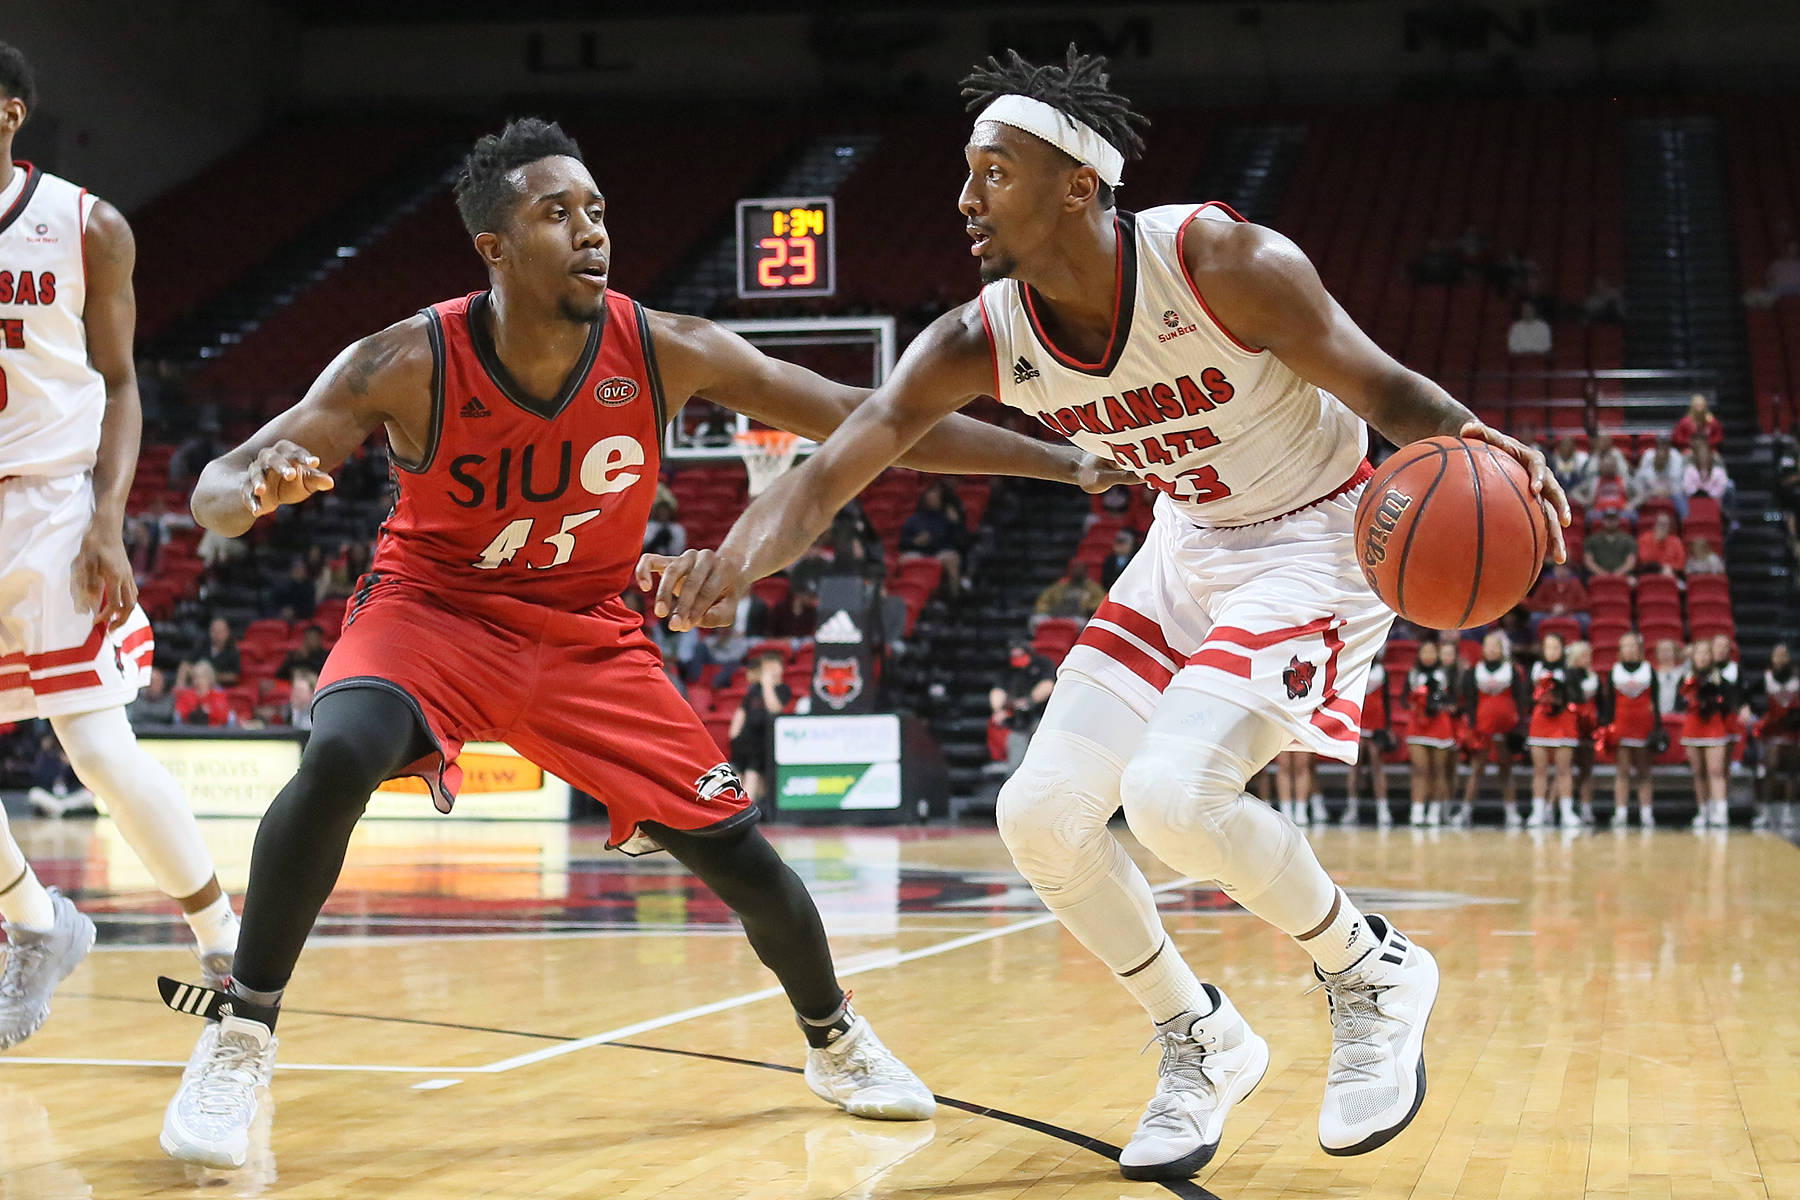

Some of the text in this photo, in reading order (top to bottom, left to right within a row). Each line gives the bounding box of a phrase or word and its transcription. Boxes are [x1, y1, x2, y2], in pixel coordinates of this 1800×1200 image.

[773, 208, 824, 237] 1:34
[758, 237, 816, 287] 23
[603, 385, 629, 399] OVC
[470, 509, 602, 570] 45
